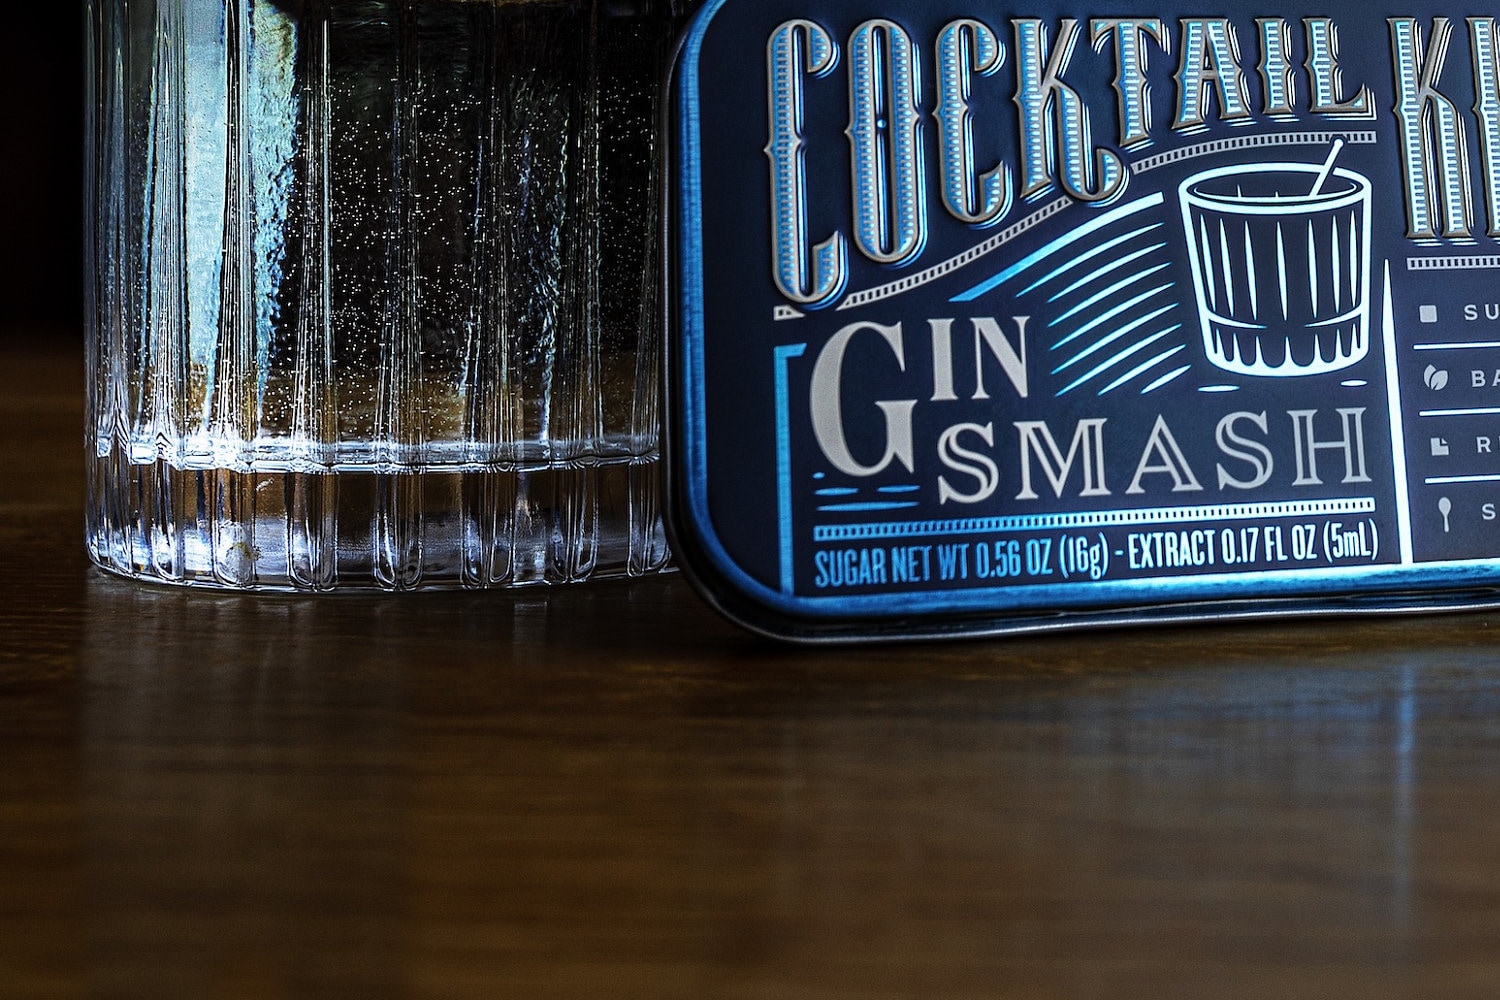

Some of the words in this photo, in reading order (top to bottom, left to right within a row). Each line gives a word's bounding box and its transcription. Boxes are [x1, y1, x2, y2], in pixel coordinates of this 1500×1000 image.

[763, 16, 1376, 308] COCKTAIL
[936, 406, 1373, 505] SMASH
[814, 547, 888, 588] SUGAR
[891, 545, 933, 583] NET
[936, 543, 970, 580] WT
[975, 539, 1021, 579] 0.56
[1025, 537, 1053, 576] OZ
[1059, 531, 1109, 580] (16g)
[1127, 529, 1216, 570] EXTRACT
[1221, 526, 1260, 565] 0.17
[1264, 525, 1288, 562] FL
[1291, 523, 1318, 560] OZ
[1323, 518, 1379, 563] (5mL)
